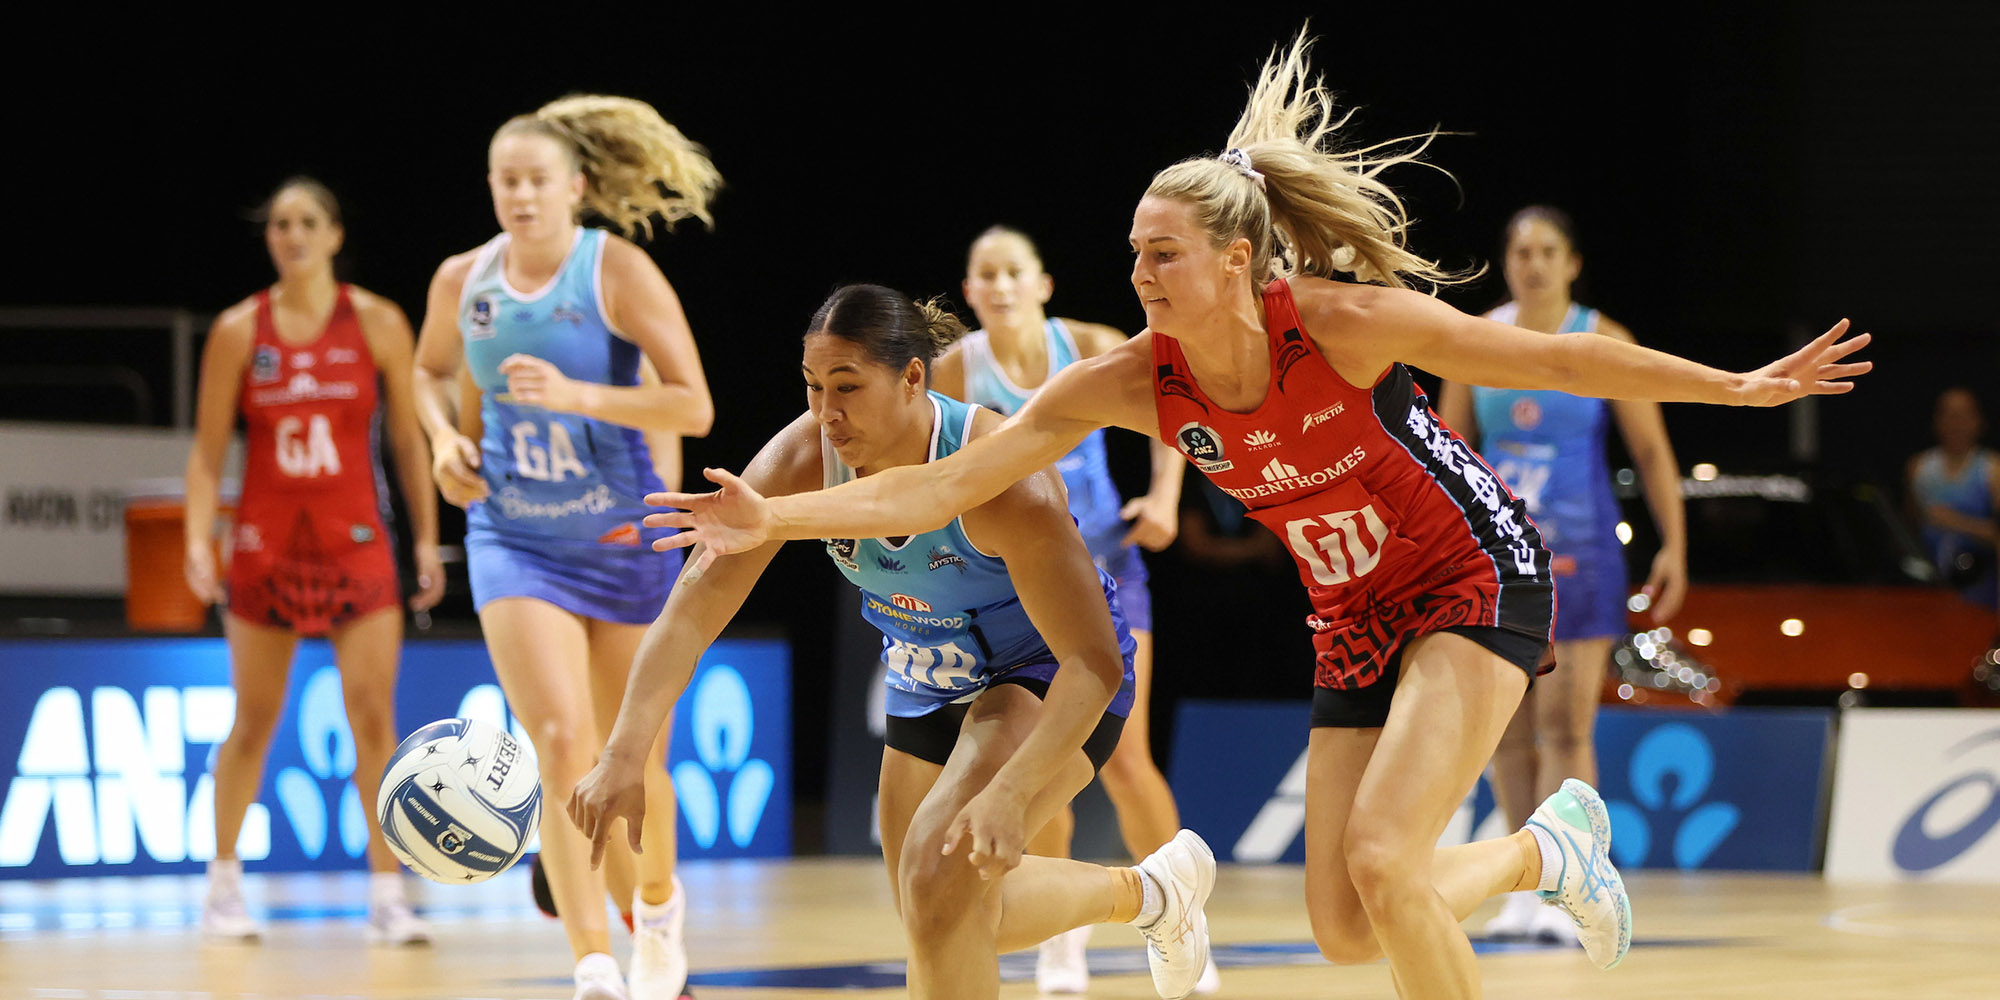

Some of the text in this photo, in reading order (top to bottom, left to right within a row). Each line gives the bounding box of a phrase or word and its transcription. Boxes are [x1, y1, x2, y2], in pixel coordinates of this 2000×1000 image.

[1313, 403, 1345, 425] TACTIX
[275, 413, 342, 478] GA
[511, 420, 588, 483] GA
[1194, 445, 1214, 455] ANZ
[1248, 441, 1282, 452] PALADIN
[867, 598, 963, 629] STONEWOOD
[895, 621, 930, 635] HOMES
[0, 686, 270, 866] ANZ
[486, 730, 517, 793] BERT
[407, 797, 440, 826] PREMIERSHIP
